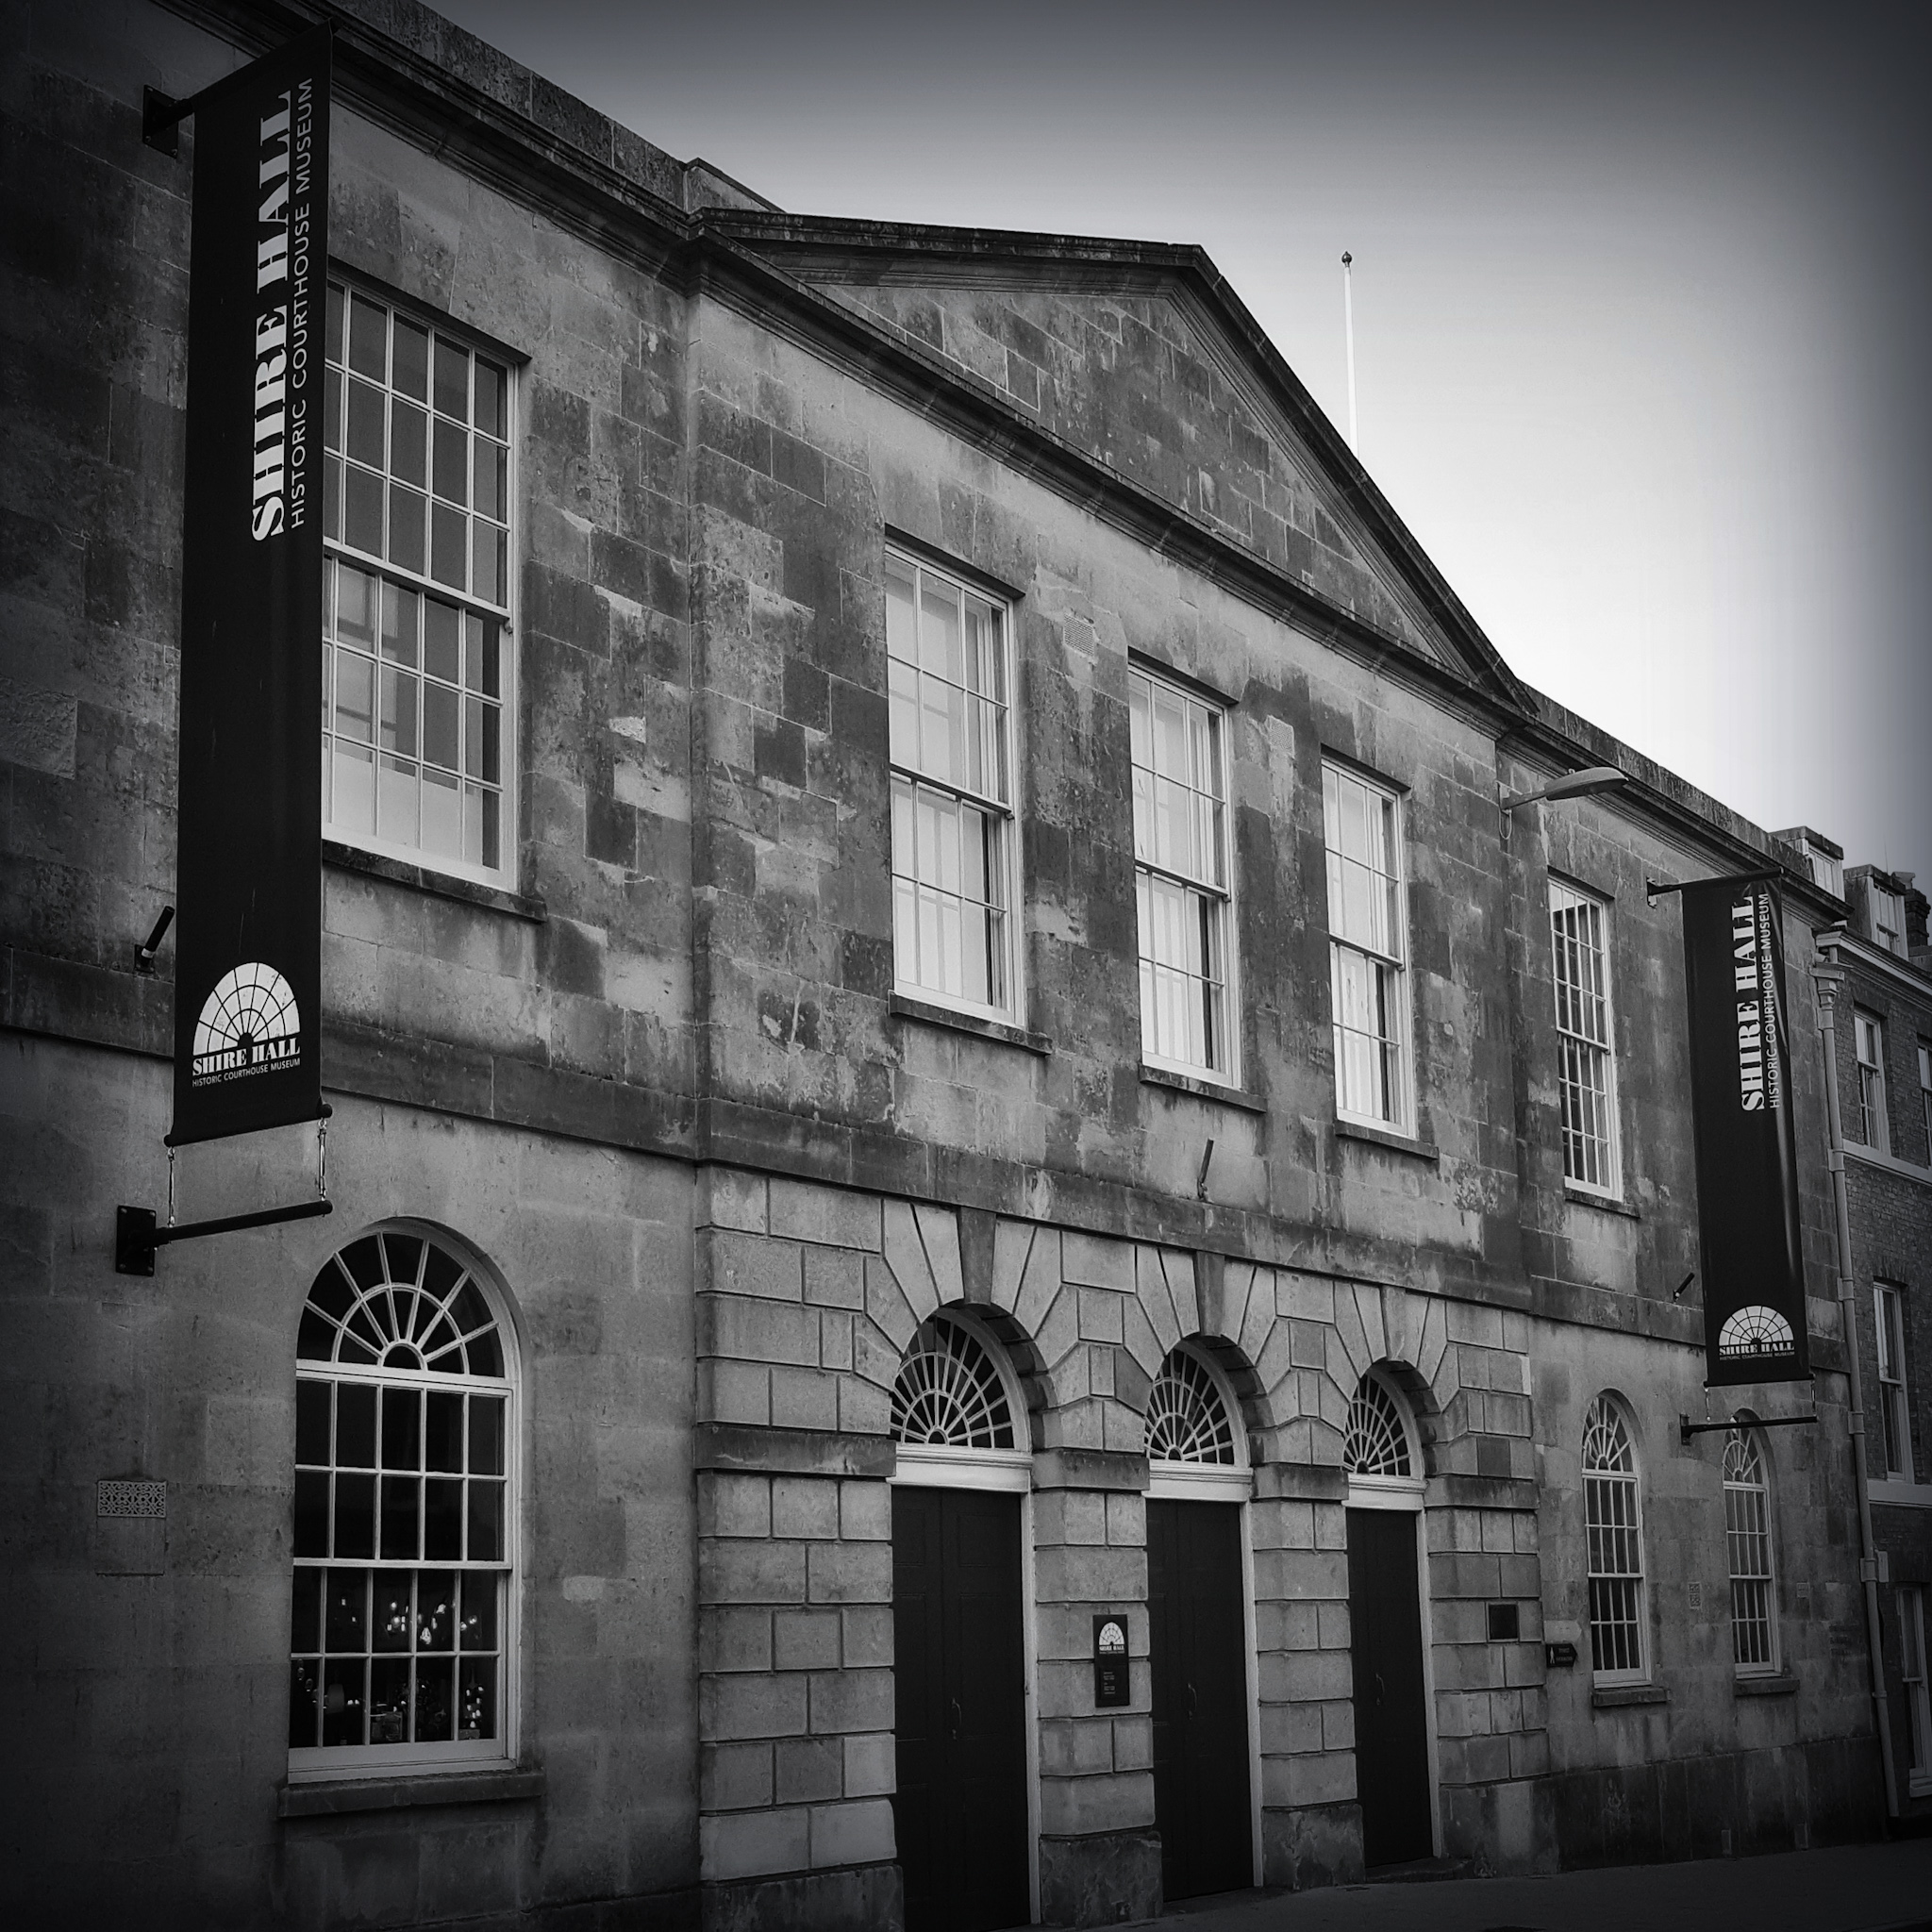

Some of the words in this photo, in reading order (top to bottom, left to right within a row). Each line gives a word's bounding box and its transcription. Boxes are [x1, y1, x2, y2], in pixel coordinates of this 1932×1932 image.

[295, 77, 313, 194] MUSEUM
[257, 91, 291, 293] HALL
[291, 203, 309, 389] COURTHOUSE
[251, 305, 288, 541] SHIRE
[291, 399, 307, 528] HISTORIC
[1731, 896, 1758, 992] HALL
[1758, 893, 1772, 950] MUSEUM
[1761, 955, 1776, 1043] COURTHOUSE
[192, 1049, 247, 1076] SHIRE
[251, 1038, 300, 1064] HALL
[192, 1074, 222, 1087] HISTORIC
[224, 1064, 269, 1081] COURTHOUSE
[271, 1058, 301, 1071] MUSEUM
[1737, 1000, 1765, 1110] SHIRE
[1766, 1048, 1779, 1108] HISTORIC
[1719, 1344, 1758, 1356] SHIRE
[1760, 1341, 1794, 1353] HALL
